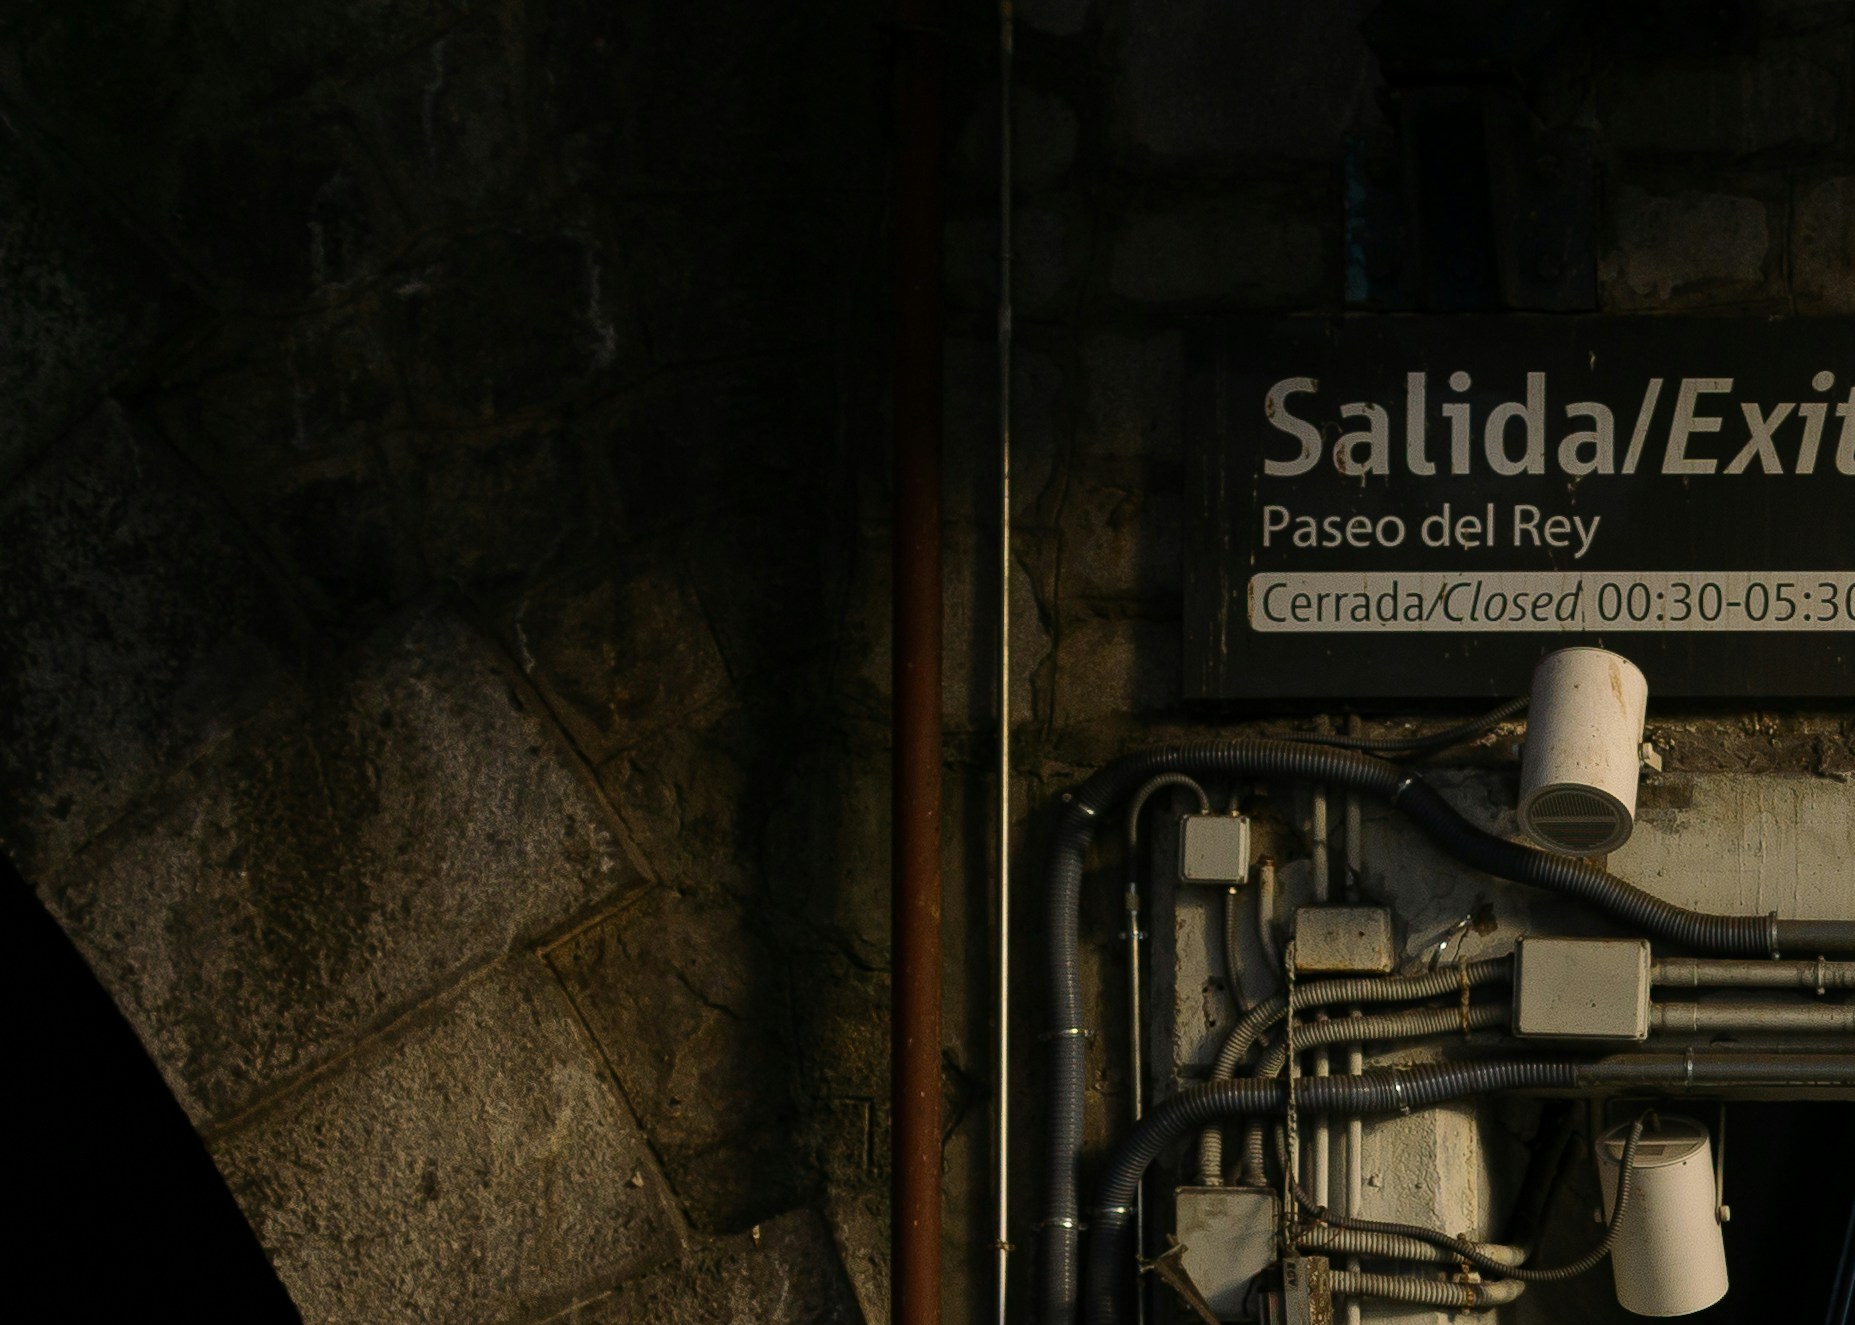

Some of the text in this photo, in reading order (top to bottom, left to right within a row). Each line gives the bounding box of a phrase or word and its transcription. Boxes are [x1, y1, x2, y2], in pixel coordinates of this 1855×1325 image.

[1262, 502, 1601, 559] Paseo del Rey
[1262, 581, 1583, 623] Cerrada/Closed
